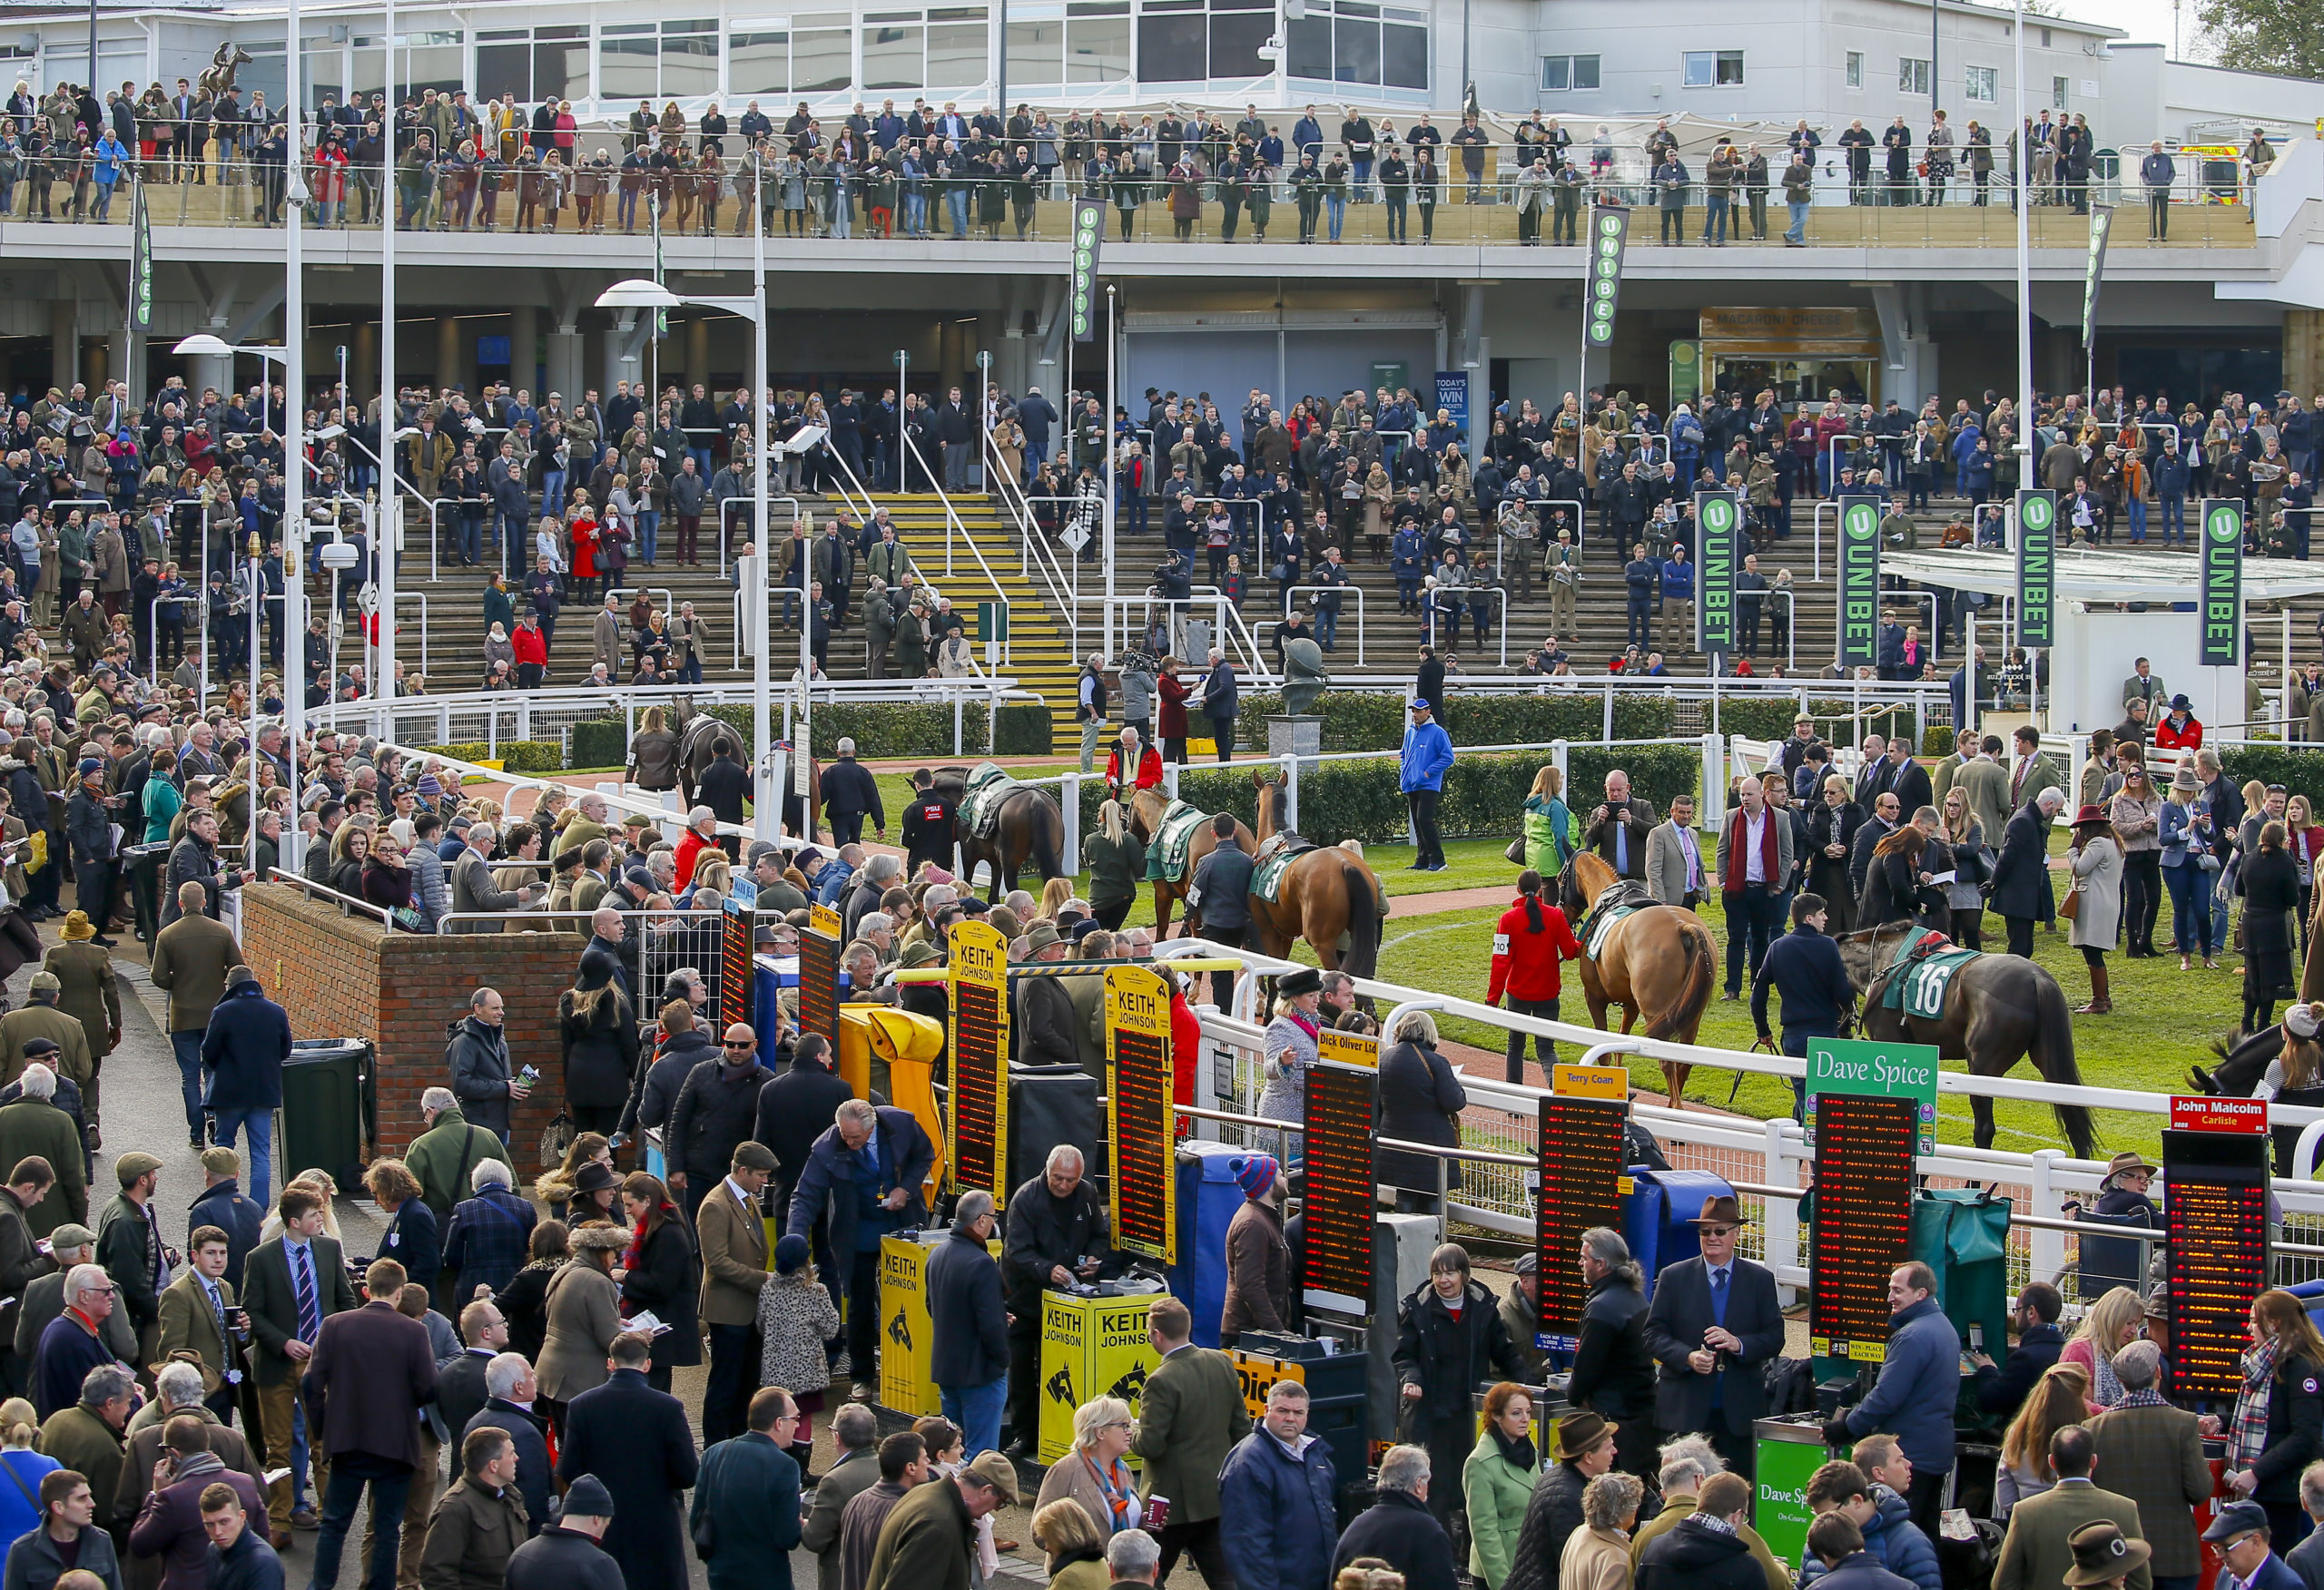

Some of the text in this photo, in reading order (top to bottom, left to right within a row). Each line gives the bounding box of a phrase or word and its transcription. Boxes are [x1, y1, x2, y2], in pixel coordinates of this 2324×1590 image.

[1595, 219, 1617, 338] UNIBET
[1717, 313, 1785, 326] MACARONI
[1439, 391, 1462, 403] WIN
[1073, 528, 1078, 542] 1
[369, 590, 377, 605] 2
[1706, 538, 1729, 644] UNIBET
[2024, 535, 2049, 640] UNIBET
[1846, 545, 1874, 658] UNIBET
[2207, 547, 2236, 659] UNIBET
[924, 805, 940, 813] PSU
[734, 880, 745, 897] MARK
[1264, 859, 1286, 898] 3
[812, 905, 840, 928] Dick Oliver
[960, 945, 994, 968] KEITH
[1496, 943, 1505, 952] 10
[960, 966, 994, 982] JOHNSON
[1915, 963, 1951, 1015] 16
[1118, 990, 1156, 1015] KEITH
[1118, 1012, 1157, 1029] JOHNSON
[1320, 1034, 1376, 1055] Dick Oliver Ltd
[1567, 1073, 1613, 1085] Terry Coan
[1816, 1051, 1929, 1093] Dave Spice
[2175, 1100, 2262, 1114] John Malcolm
[2201, 1115, 2238, 1125] Carlisle
[885, 1254, 917, 1278] KEITH
[884, 1274, 917, 1291] JOHNSON
[1047, 1308, 1081, 1333] KEITH
[1102, 1312, 1149, 1333] KEIT
[1045, 1329, 1081, 1348] JOHNSON
[1235, 1369, 1277, 1404] Dic
[1760, 1484, 1791, 1503] Dave
[1777, 1513, 1807, 1523] On-Course
